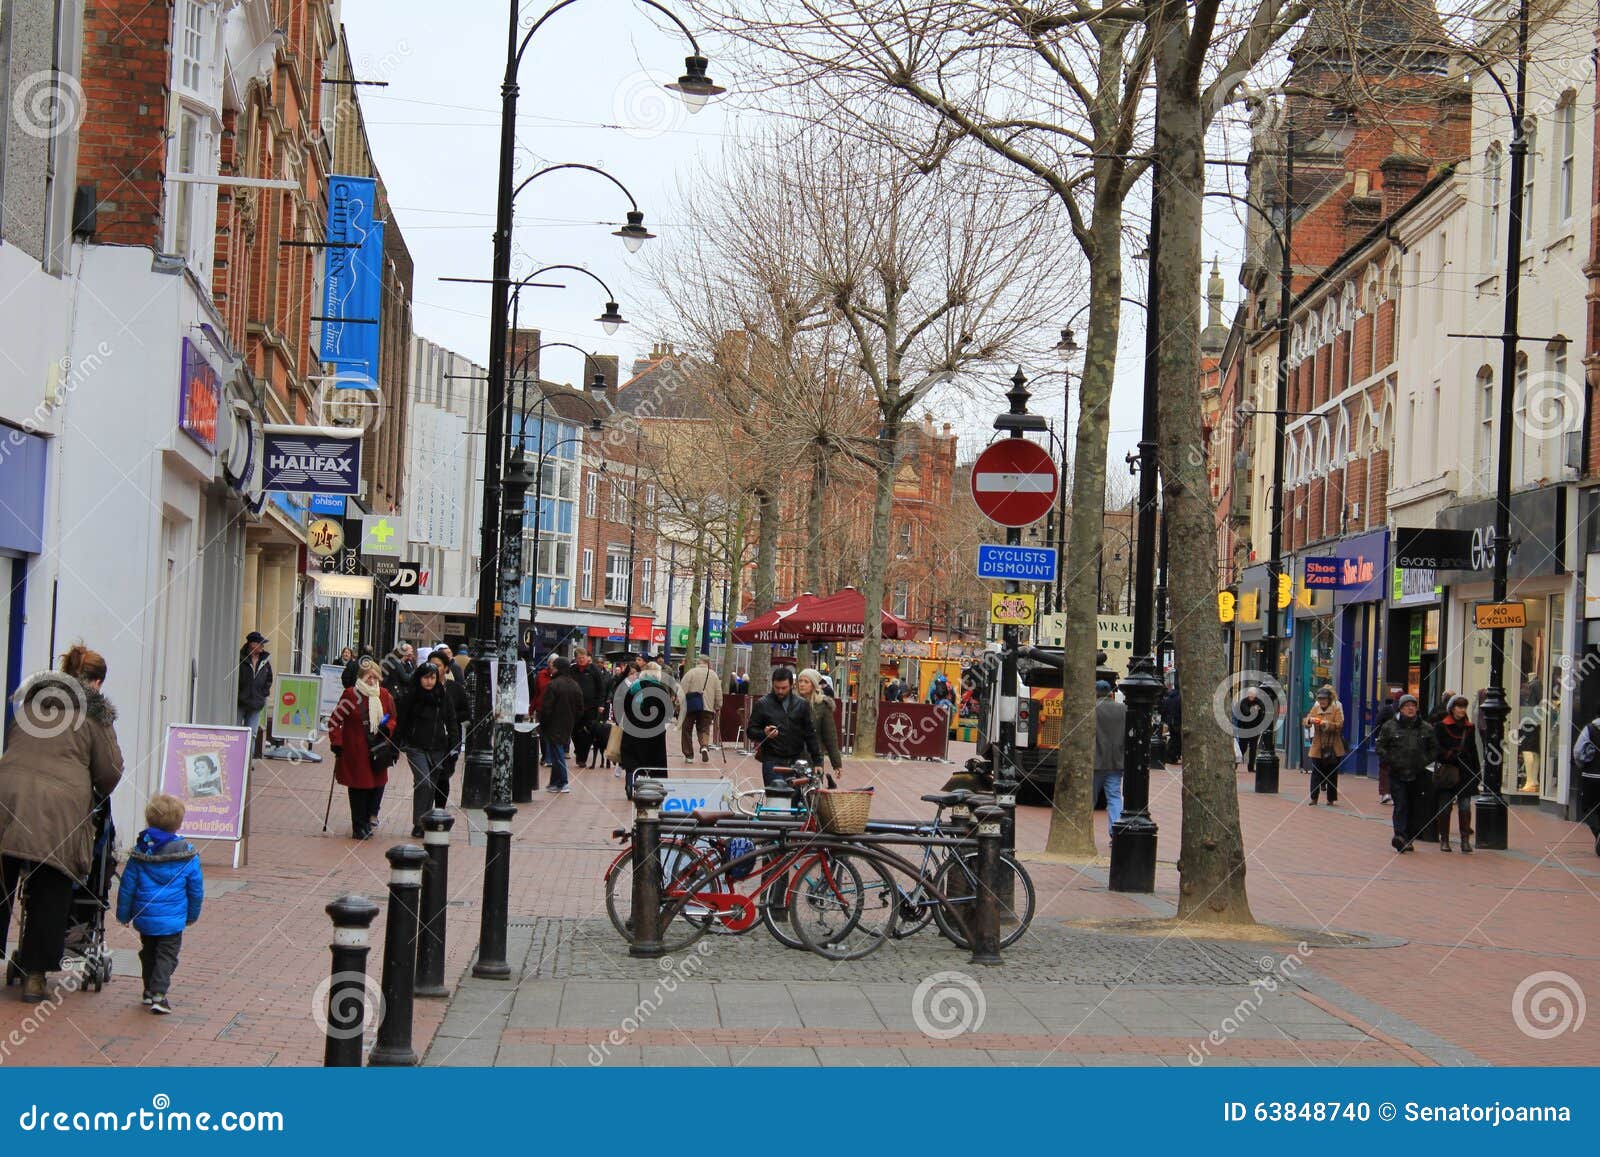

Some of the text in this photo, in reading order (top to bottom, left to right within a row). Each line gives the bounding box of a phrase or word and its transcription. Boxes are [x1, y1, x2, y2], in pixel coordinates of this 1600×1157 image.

[325, 183, 349, 353] CHILTRN medica clinic
[270, 455, 352, 472] HALIFAX
[315, 496, 343, 507] ohlson
[988, 550, 1047, 563] CYCLISTS
[1400, 556, 1437, 567] evans
[983, 562, 1051, 576] DISMOUNT
[1307, 563, 1336, 573] Shoe
[1343, 558, 1357, 586] Shoe
[1357, 555, 1374, 583] Zone
[390, 568, 417, 587] JD
[1306, 574, 1336, 584] Zone
[1493, 608, 1508, 616] NO
[1480, 614, 1522, 625] CYCLING
[812, 622, 865, 634] PRET A MANGER
[760, 630, 773, 640] PRET
[774, 630, 778, 640] A
[1045, 699, 1063, 707] GX5
